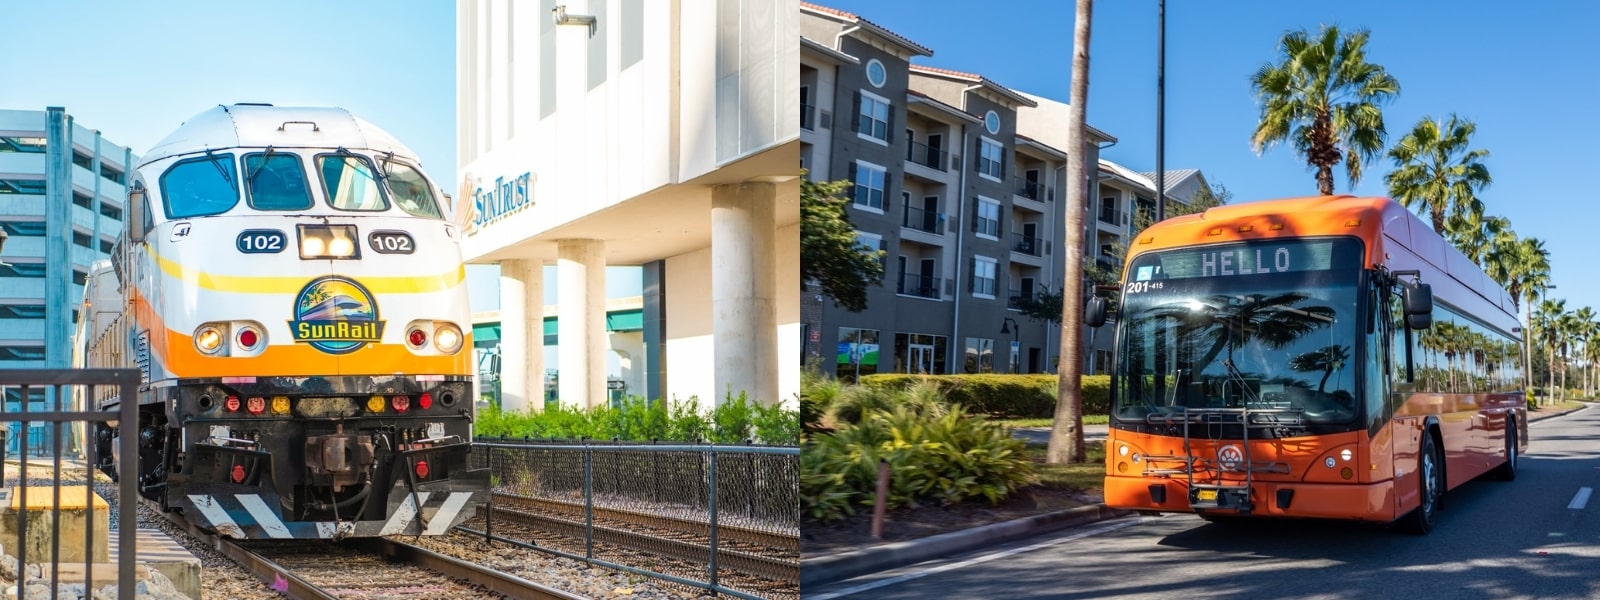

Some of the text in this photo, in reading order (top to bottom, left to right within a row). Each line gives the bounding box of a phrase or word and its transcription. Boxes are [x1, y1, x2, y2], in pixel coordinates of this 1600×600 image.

[242, 235, 281, 250] 102
[374, 237, 410, 250] 102
[1202, 247, 1289, 277] HELLO
[298, 322, 377, 339] SunRail
